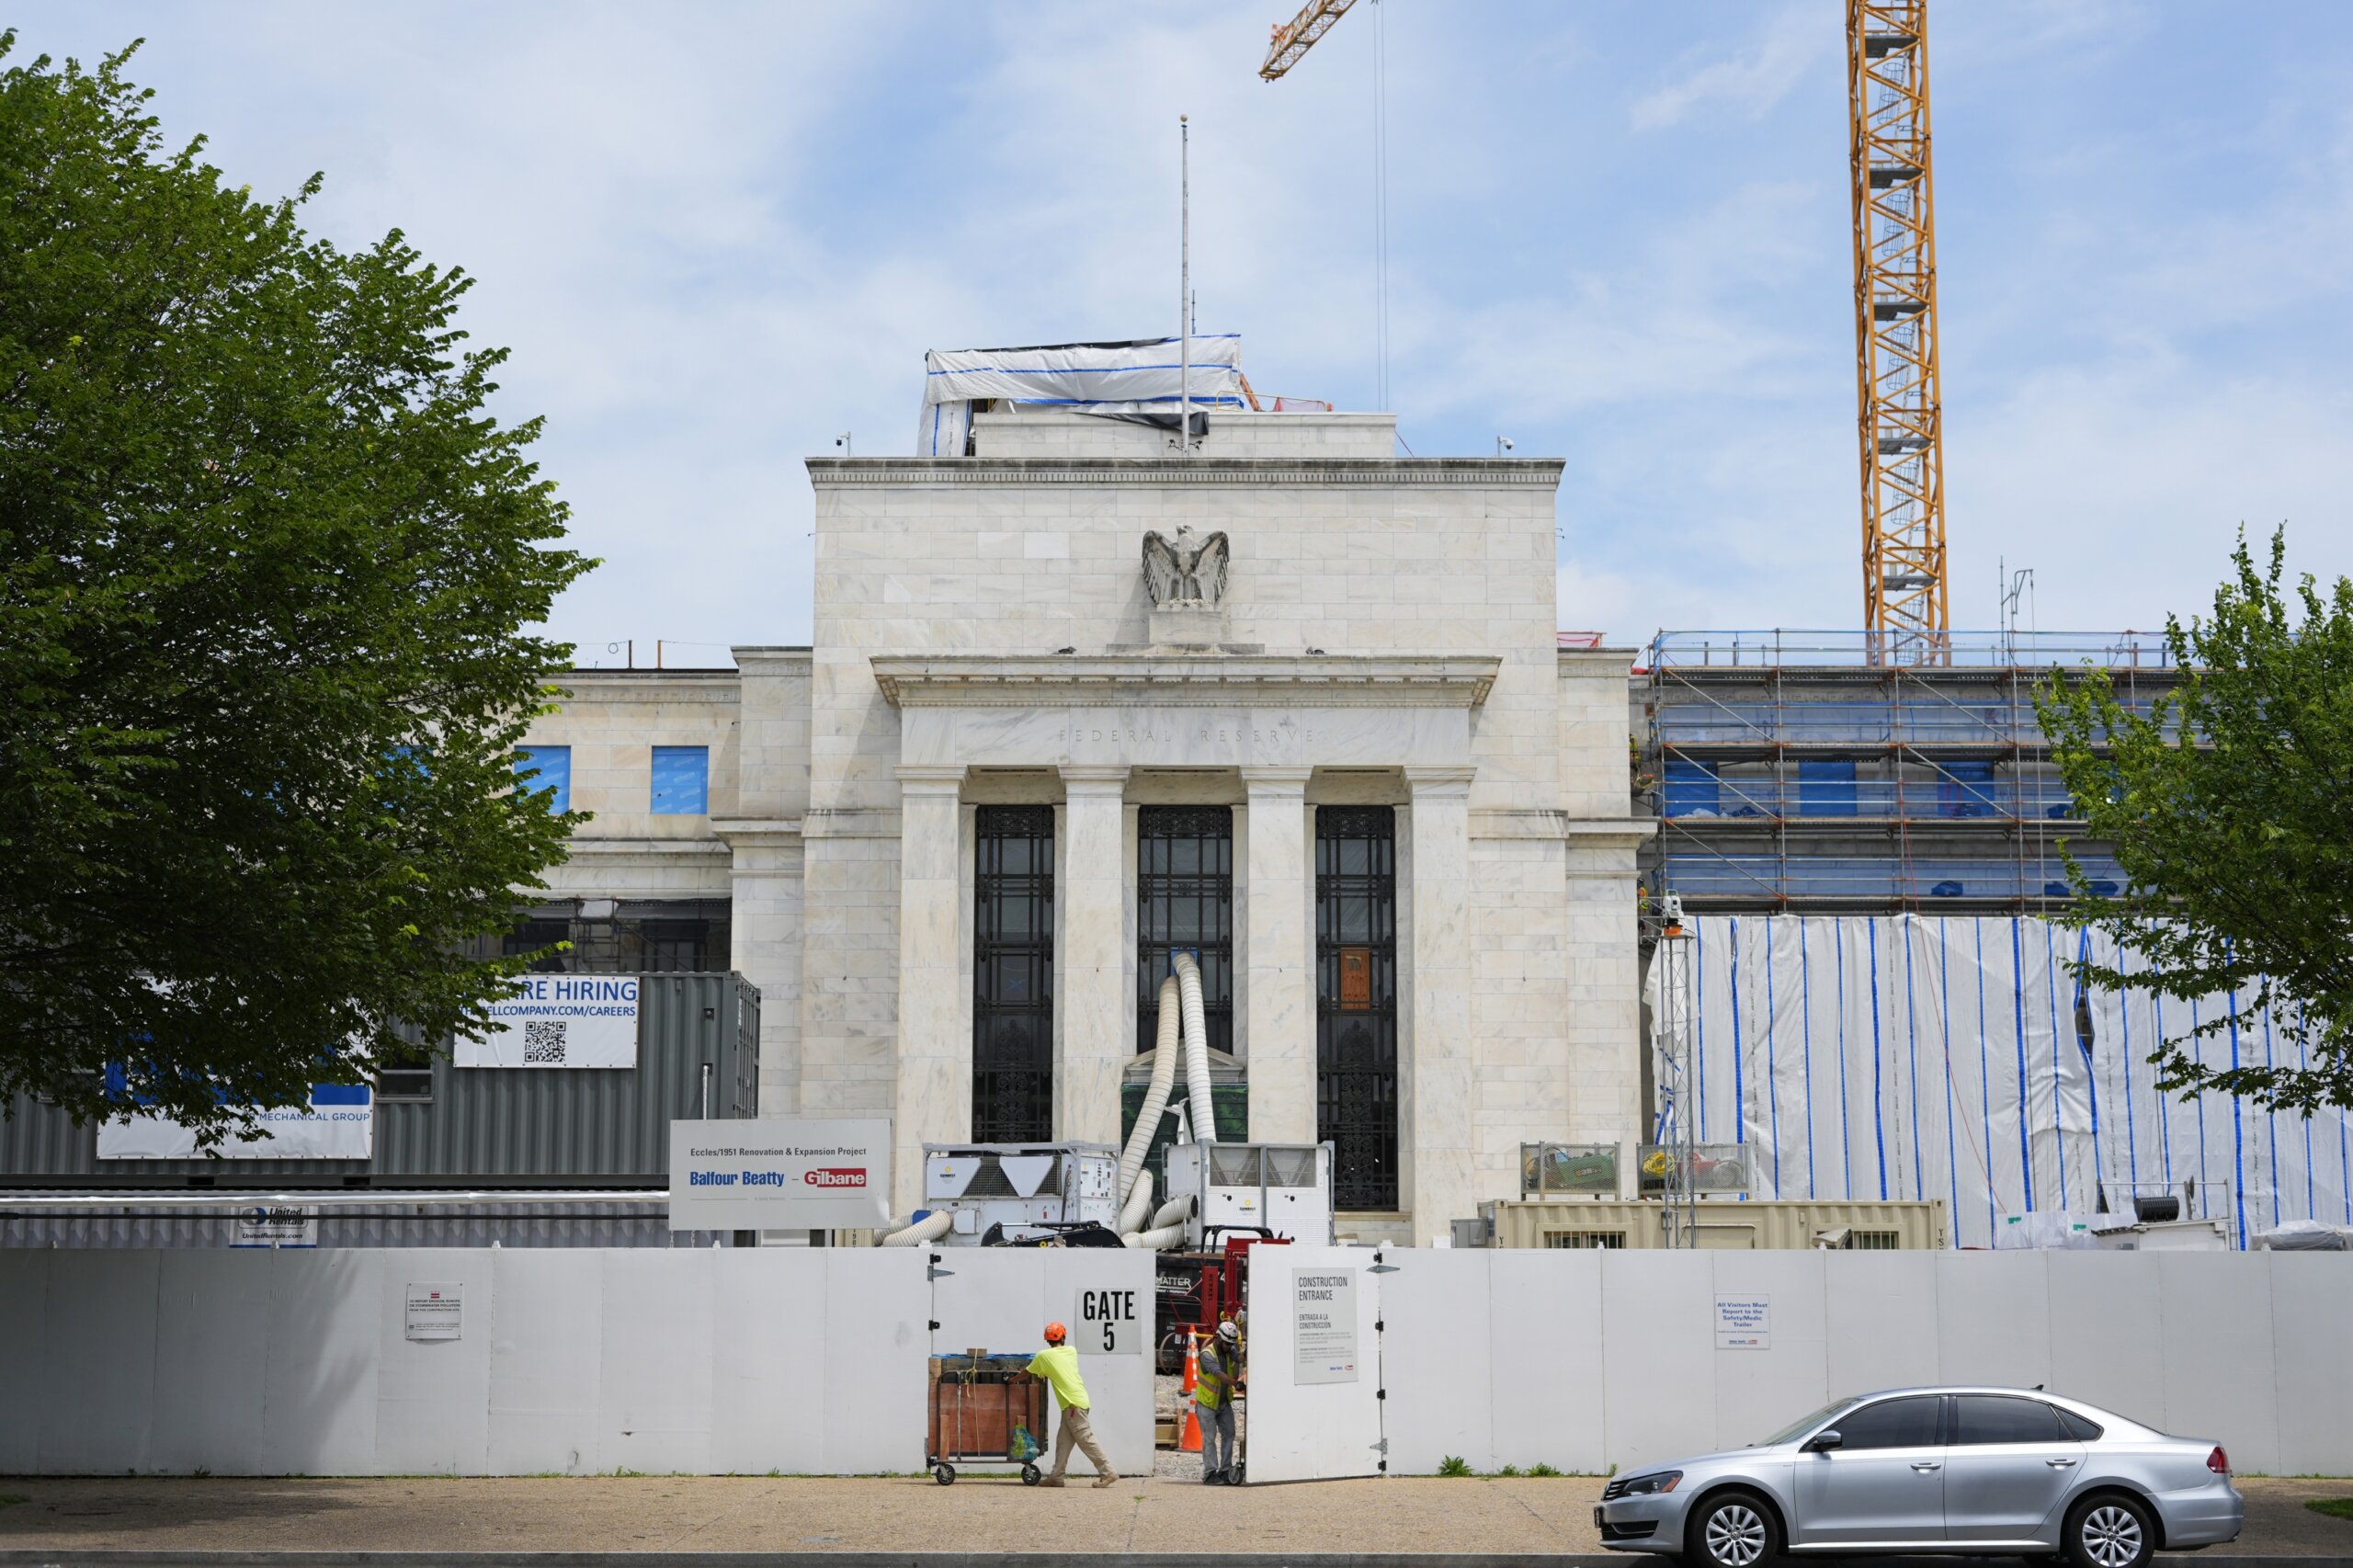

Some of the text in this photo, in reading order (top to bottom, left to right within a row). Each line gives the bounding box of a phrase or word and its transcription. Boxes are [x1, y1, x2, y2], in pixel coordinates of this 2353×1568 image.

[1059, 730, 1313, 743] FEDERAL RESERVE
[556, 981, 637, 1002] HIRING
[259, 1113, 328, 1121] MECHANICAL
[332, 1113, 370, 1121] GROUP
[690, 1147, 867, 1158] Eccles/1951 Renovation & Expansion Project
[690, 1171, 738, 1186] Balfour
[742, 1171, 785, 1187] Beatty
[804, 1170, 866, 1186] Gilbane
[268, 1208, 302, 1217] United
[268, 1217, 304, 1225] Rentals
[1298, 1276, 1348, 1288] CONSTRUCTION
[1299, 1290, 1333, 1301] ENTRANCE
[1084, 1290, 1135, 1321] GATE
[1103, 1322, 1115, 1352] 5
